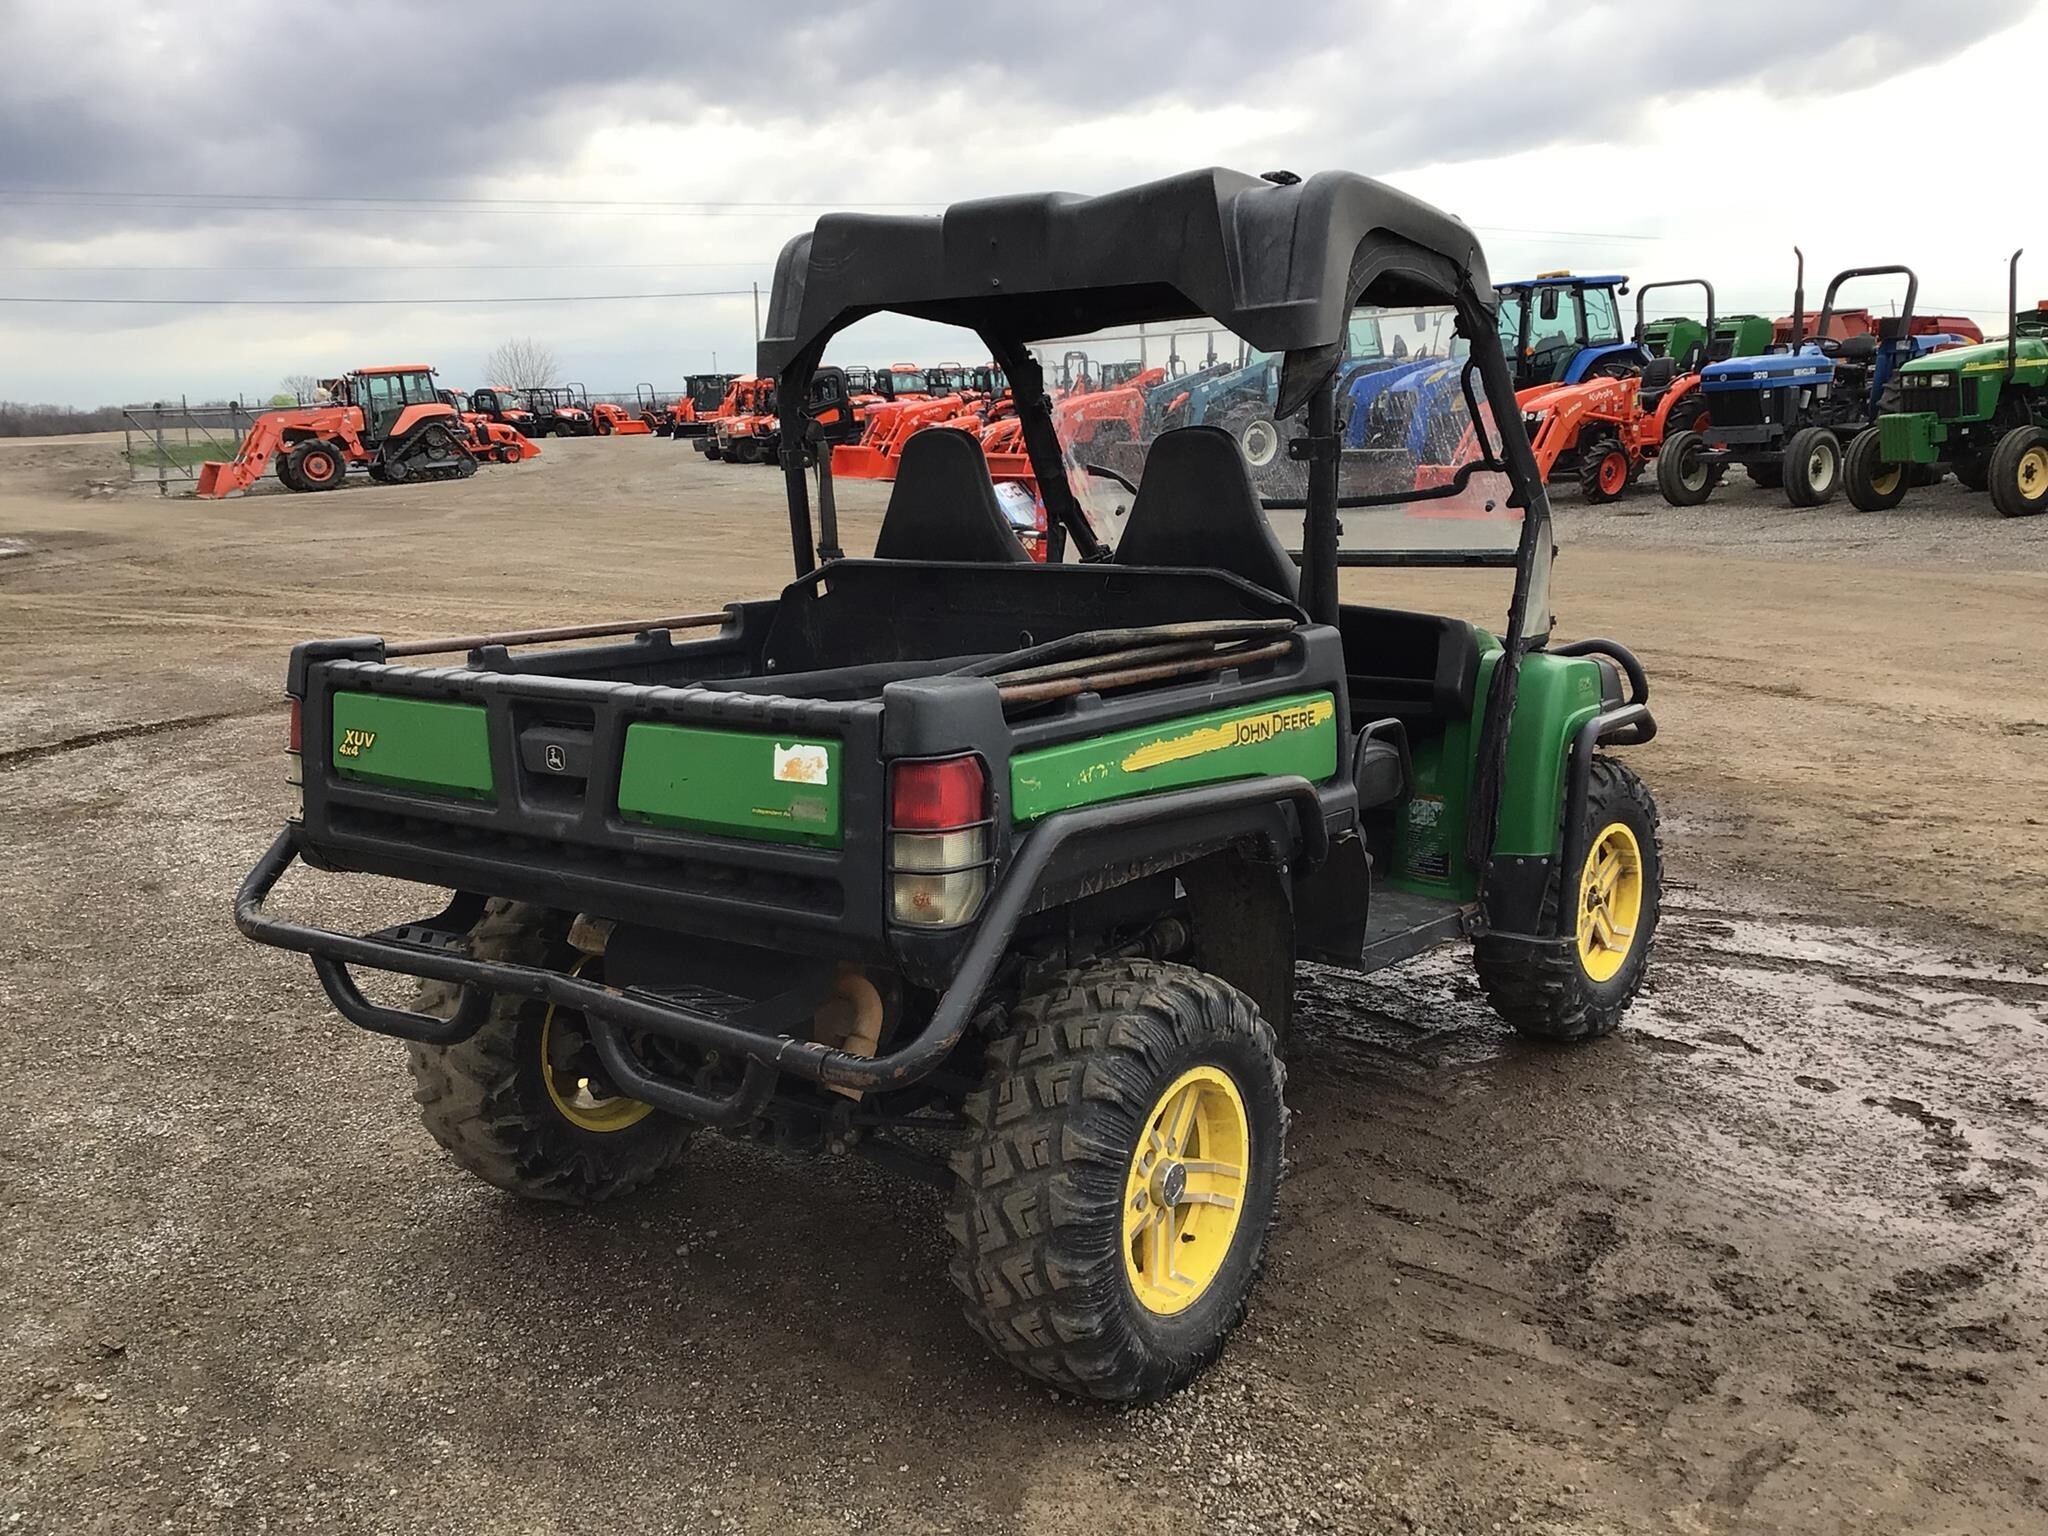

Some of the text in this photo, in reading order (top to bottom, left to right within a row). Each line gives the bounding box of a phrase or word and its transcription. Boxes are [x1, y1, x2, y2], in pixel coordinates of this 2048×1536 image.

[1233, 710, 1316, 745] JOHN DEERE
[344, 729, 375, 748] XUV
[339, 744, 359, 757] 4x4
